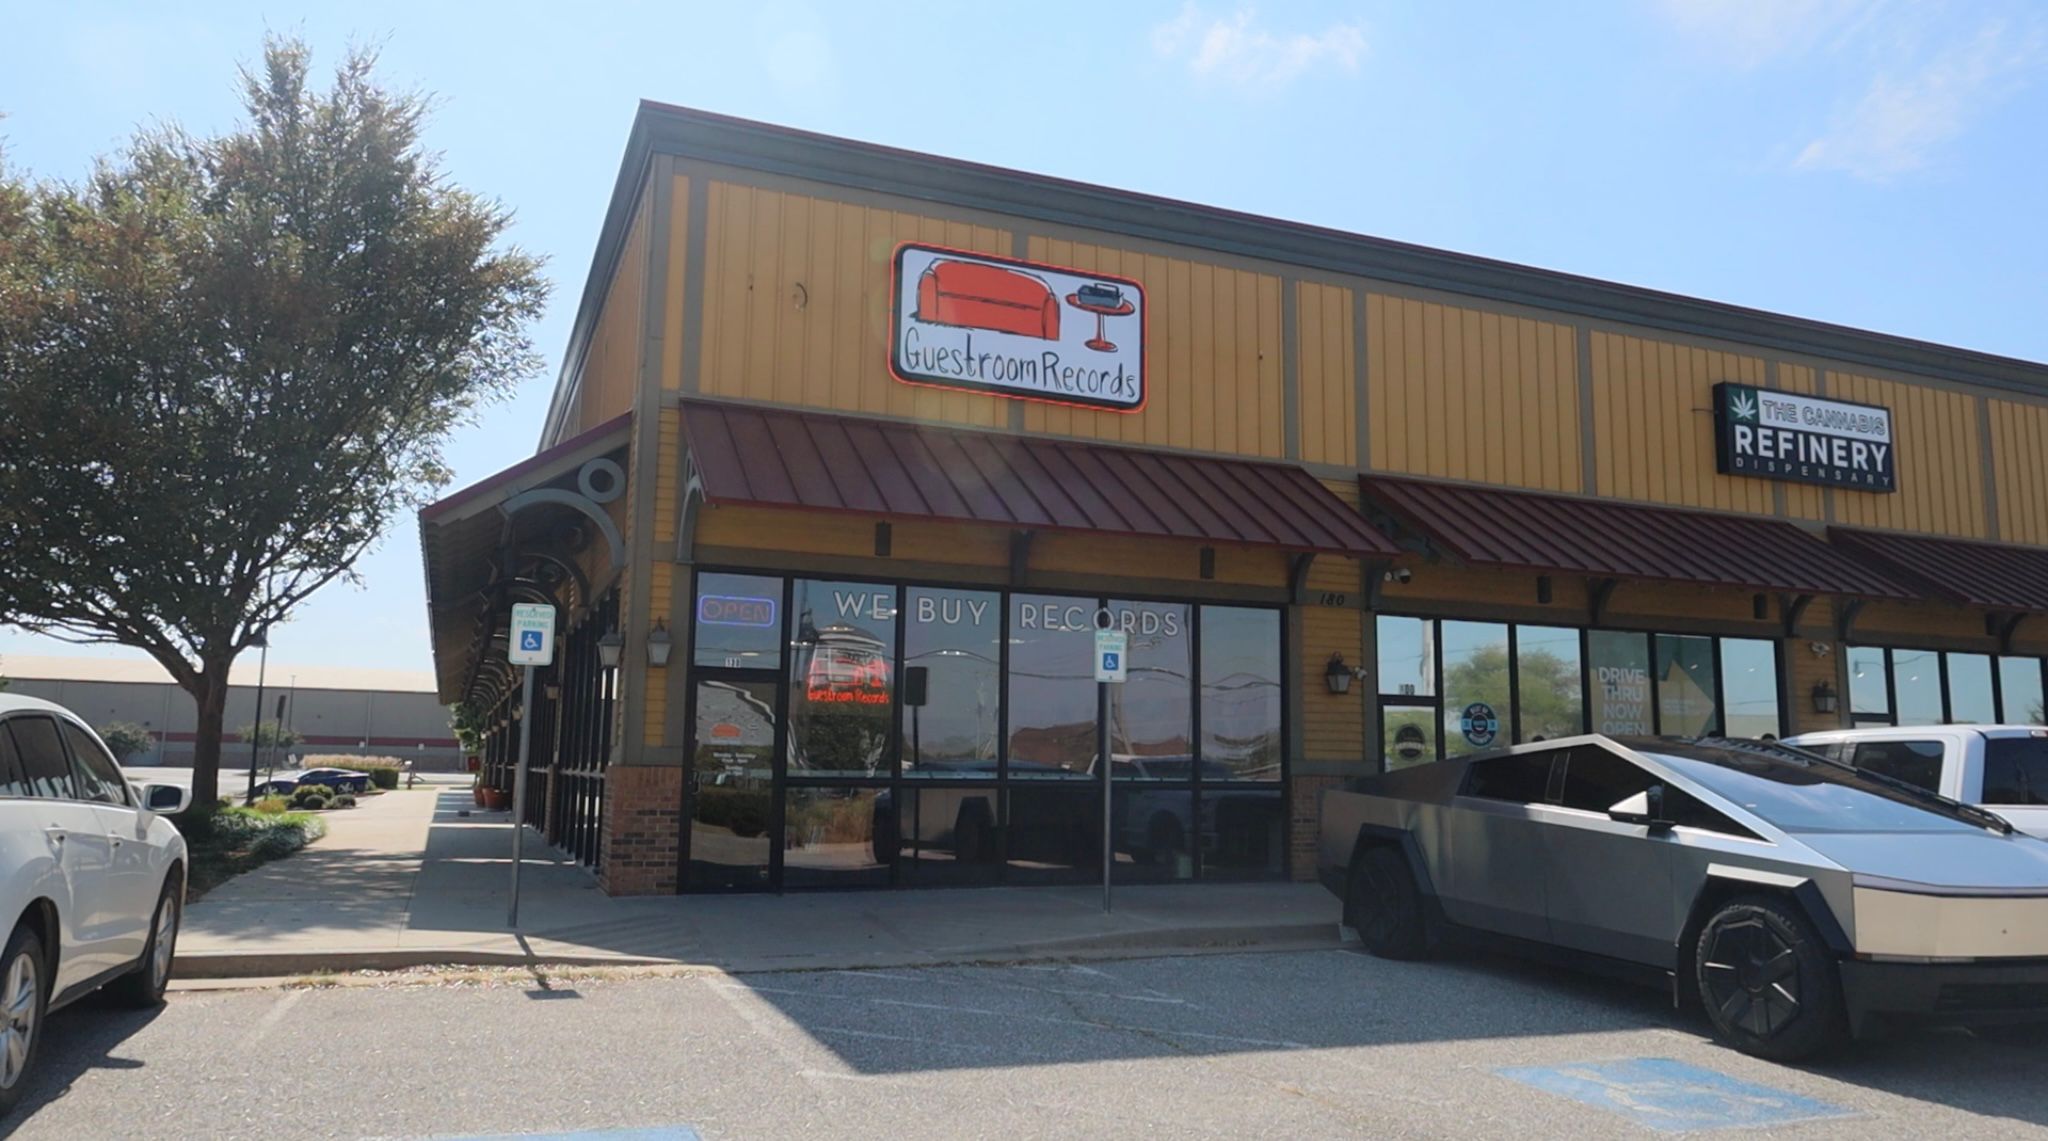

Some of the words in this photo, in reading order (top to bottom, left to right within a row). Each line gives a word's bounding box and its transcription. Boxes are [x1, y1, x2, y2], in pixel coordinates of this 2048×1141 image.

[904, 327, 1037, 384] Guestroom
[1042, 351, 1136, 399] Records
[1762, 400, 1798, 423] THE
[1802, 406, 1886, 436] CANNABIS
[1734, 424, 1888, 473] REFINERY
[1735, 457, 1890, 487] DISPENSARY
[1320, 592, 1345, 606] 180
[703, 600, 769, 622] OPEN
[833, 591, 891, 620] WE
[917, 597, 988, 625] BUY
[1020, 603, 1179, 636] RECORDS
[516, 619, 549, 629] PARKING
[1599, 666, 1645, 684] DRIVE
[1602, 684, 1644, 703] THRU
[1603, 703, 1642, 719] NOW
[1603, 721, 1646, 737] OPEN
